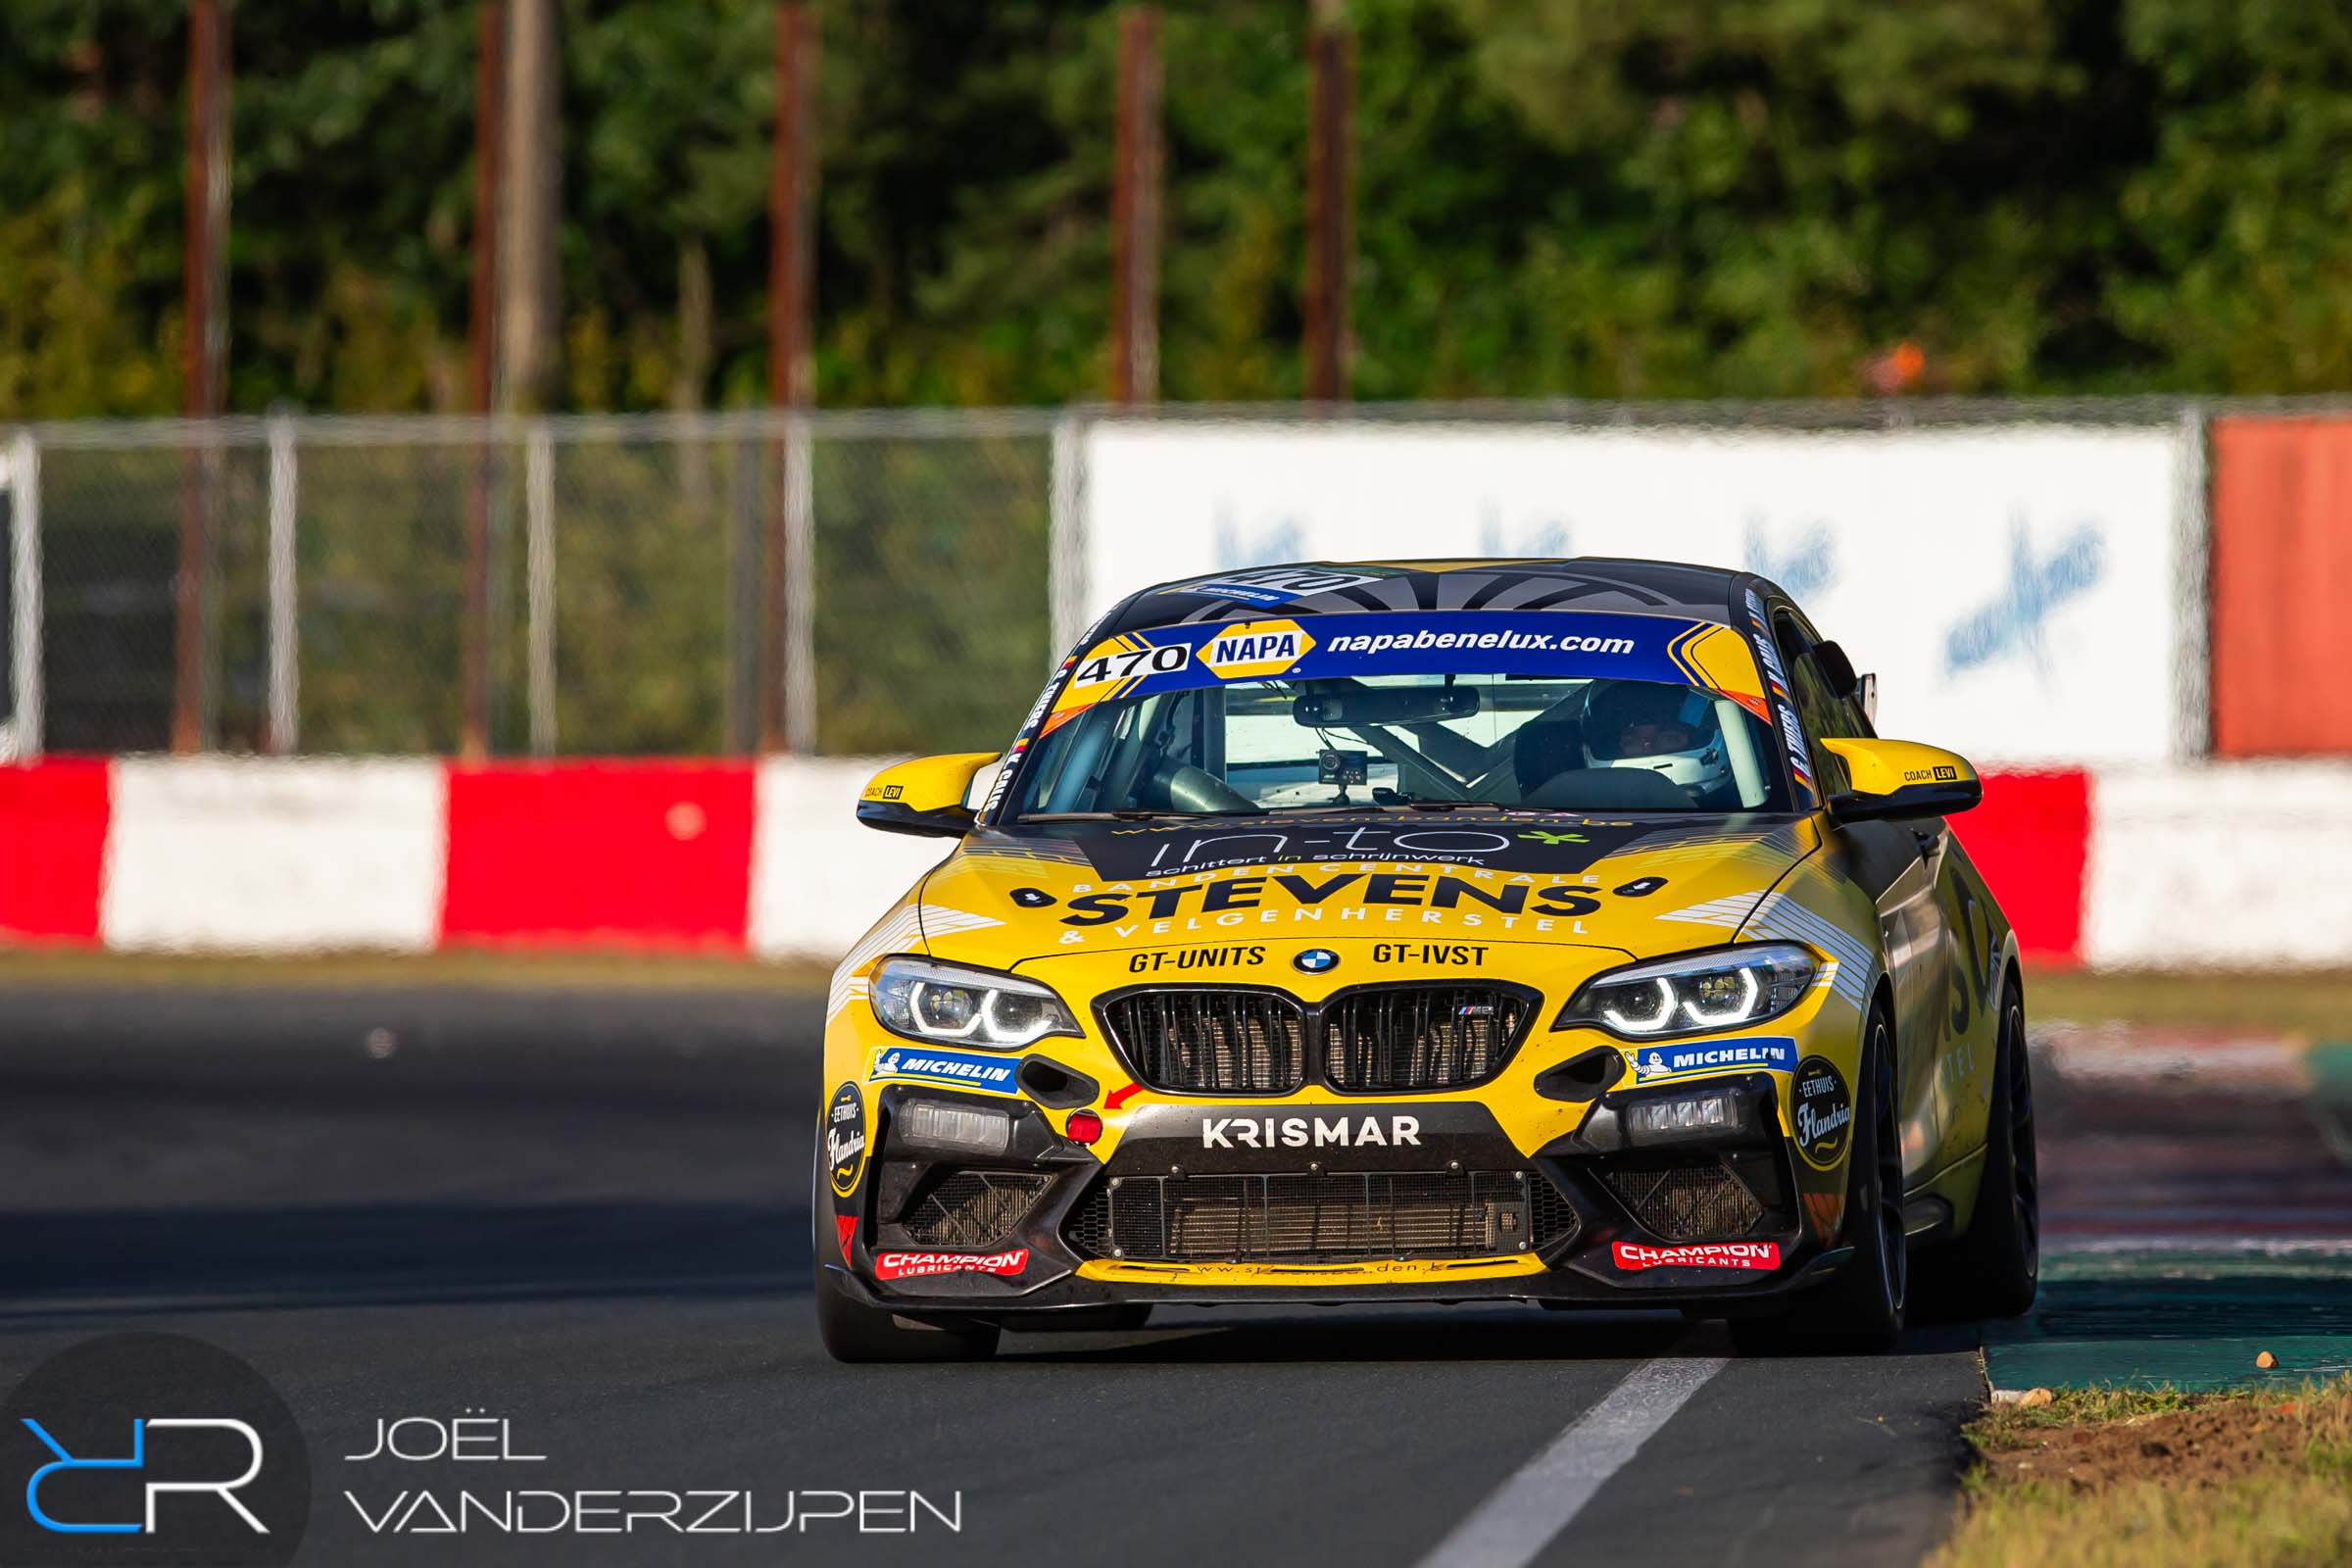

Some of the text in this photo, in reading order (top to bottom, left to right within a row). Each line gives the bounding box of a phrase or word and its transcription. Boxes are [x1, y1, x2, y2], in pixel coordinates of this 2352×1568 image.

[1215, 634, 1295, 662] NAPA
[1327, 630, 1636, 654] napabenelux.com
[1076, 646, 1188, 682] 470
[1904, 767, 1955, 781] COACH LEVI
[885, 787, 902, 798] LEVI
[1277, 854, 1301, 862] in
[1312, 853, 1486, 866] schrijnwerk
[1058, 873, 1603, 926] STEVENS
[1058, 907, 1589, 945] & VELGENHERSTEL
[1129, 946, 1266, 972] GT-UNITS
[1373, 944, 1489, 965] GT-IVST
[1673, 1047, 1786, 1068] MICHELIN
[901, 1057, 1011, 1082] MICHELIN
[1802, 1075, 1835, 1098] EETHUIS
[833, 1102, 858, 1123] EETHUIS
[1202, 1115, 1422, 1149] KRISMAR
[1797, 1102, 1850, 1148] Flandria
[827, 1127, 864, 1172] Flandria
[883, 1251, 1020, 1268] CHAMPION
[1620, 1245, 1771, 1260] CHAMPION
[1642, 1254, 1751, 1267] LUBRICANTS
[898, 1264, 997, 1276] LUBRICANTS
